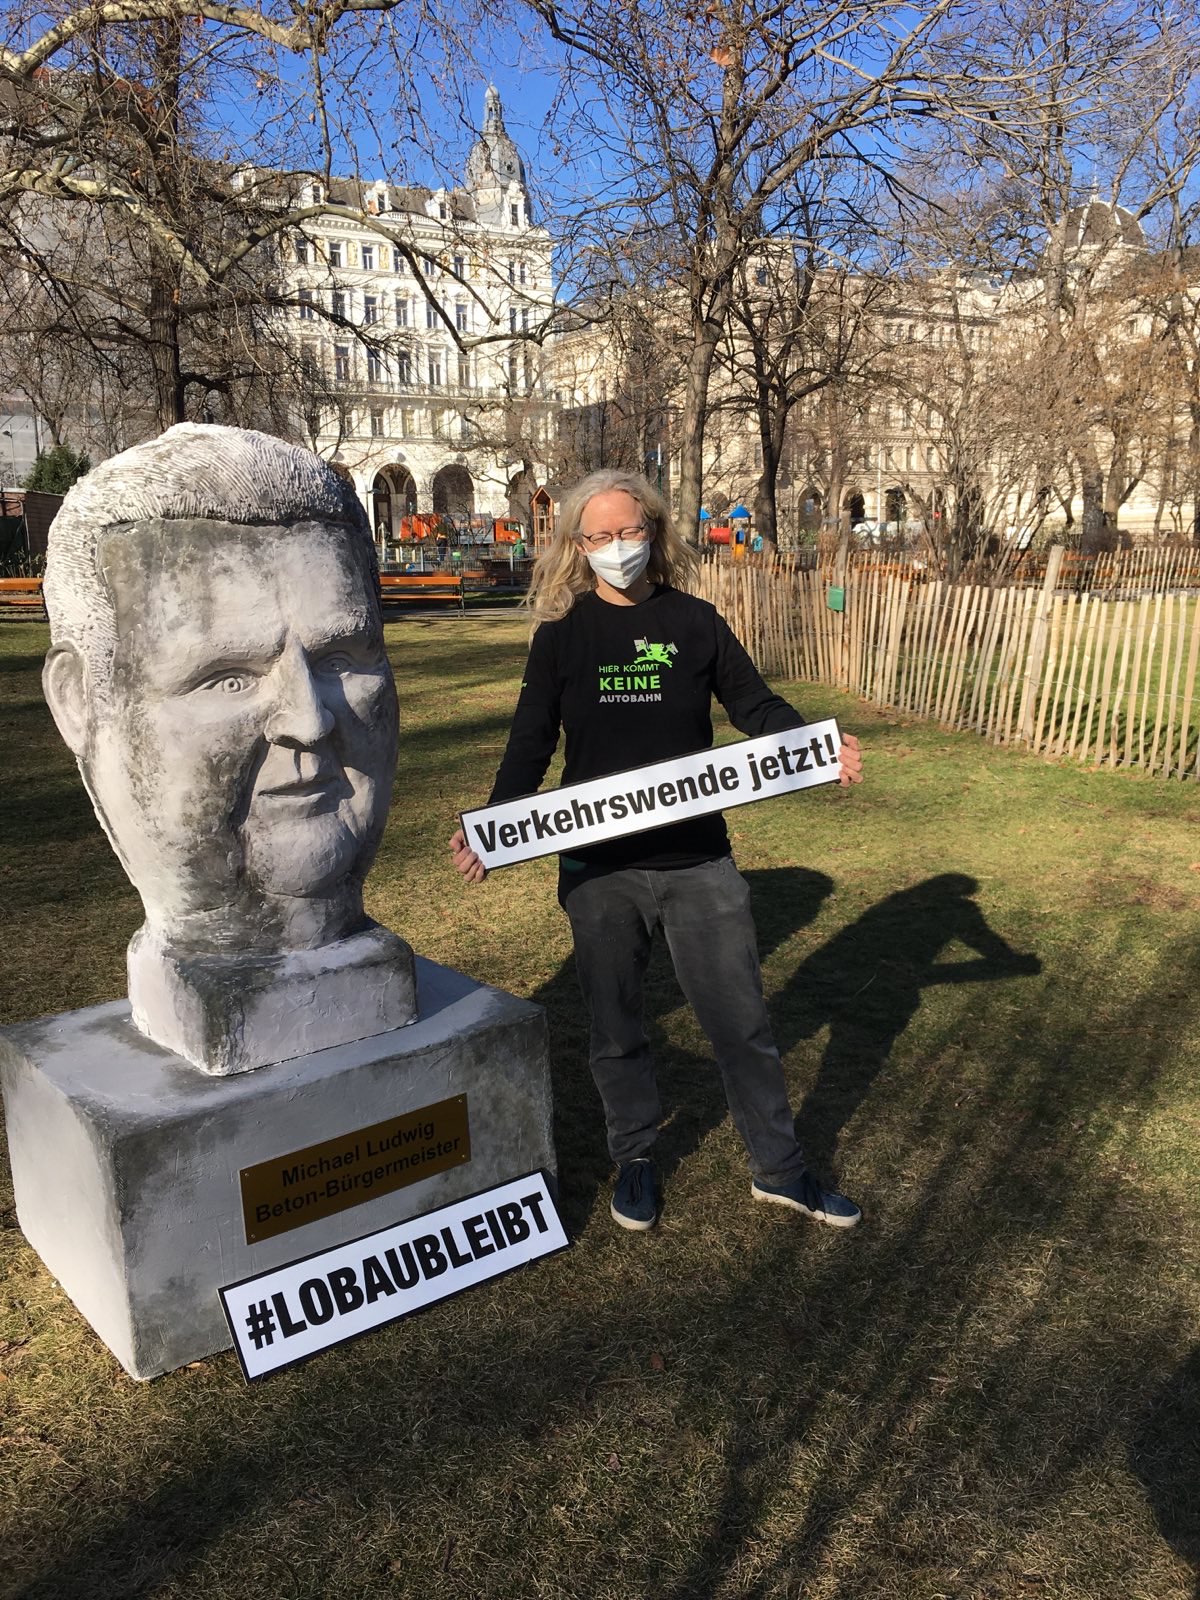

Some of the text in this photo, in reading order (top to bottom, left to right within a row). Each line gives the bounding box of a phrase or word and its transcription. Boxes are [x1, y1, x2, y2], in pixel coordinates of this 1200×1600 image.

[598, 663, 660, 673] HIER KOMMT
[599, 675, 661, 691] KEINE
[599, 693, 662, 703] AUTOBAHN
[474, 733, 838, 853] Verkehrswende jetzt!
[255, 1135, 461, 1223] Beton-Bürgermeister
[281, 1121, 435, 1187] Michael Ludwig
[245, 1192, 549, 1350] #LOBAUBLEIBT
